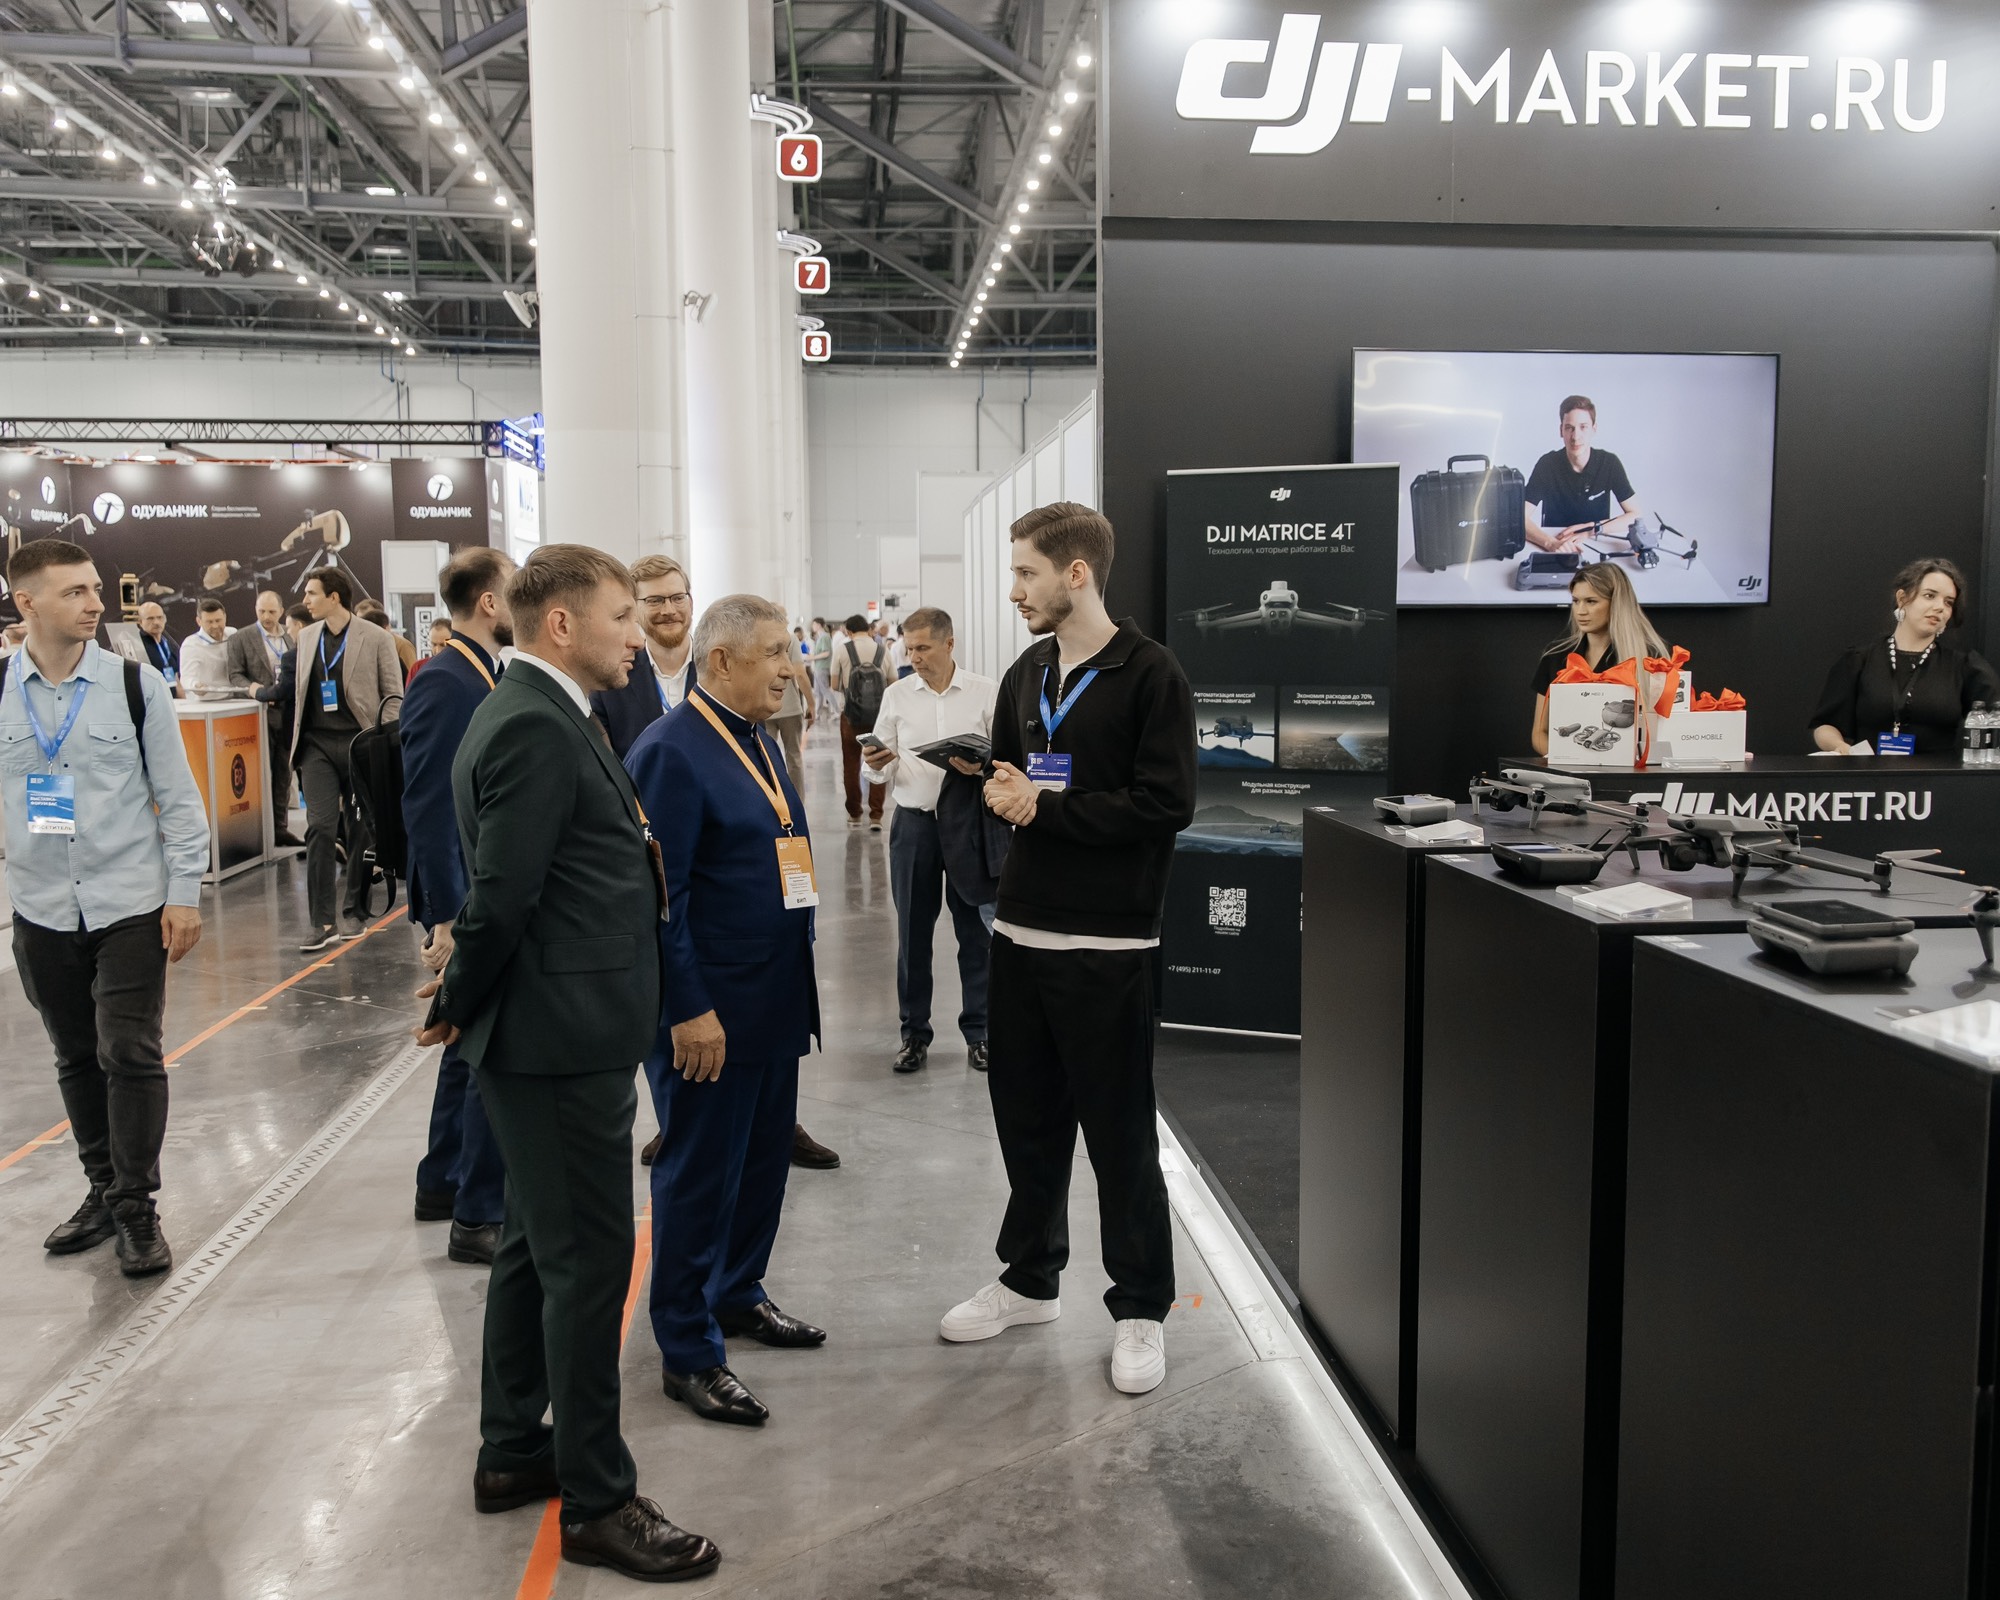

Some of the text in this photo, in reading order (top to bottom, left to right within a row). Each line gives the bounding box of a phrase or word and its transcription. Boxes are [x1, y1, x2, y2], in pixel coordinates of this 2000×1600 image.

[790, 144, 808, 171] 6
[804, 264, 820, 286] 7
[809, 337, 823, 356] 8
[131, 505, 208, 520] ОДУВАНЧИК
[410, 506, 472, 519] ОДУВАНЧИК
[1206, 522, 1355, 543] DJI MATRICE 4T
[1208, 546, 1254, 555] Технологии,
[1255, 547, 1289, 556] которые
[1290, 545, 1328, 554] работают
[1341, 545, 1355, 553] Вас
[1193, 691, 1235, 699] Автоматизация
[1274, 782, 1311, 790] конструкция
[1192, 967, 1221, 975] 211-11-07
